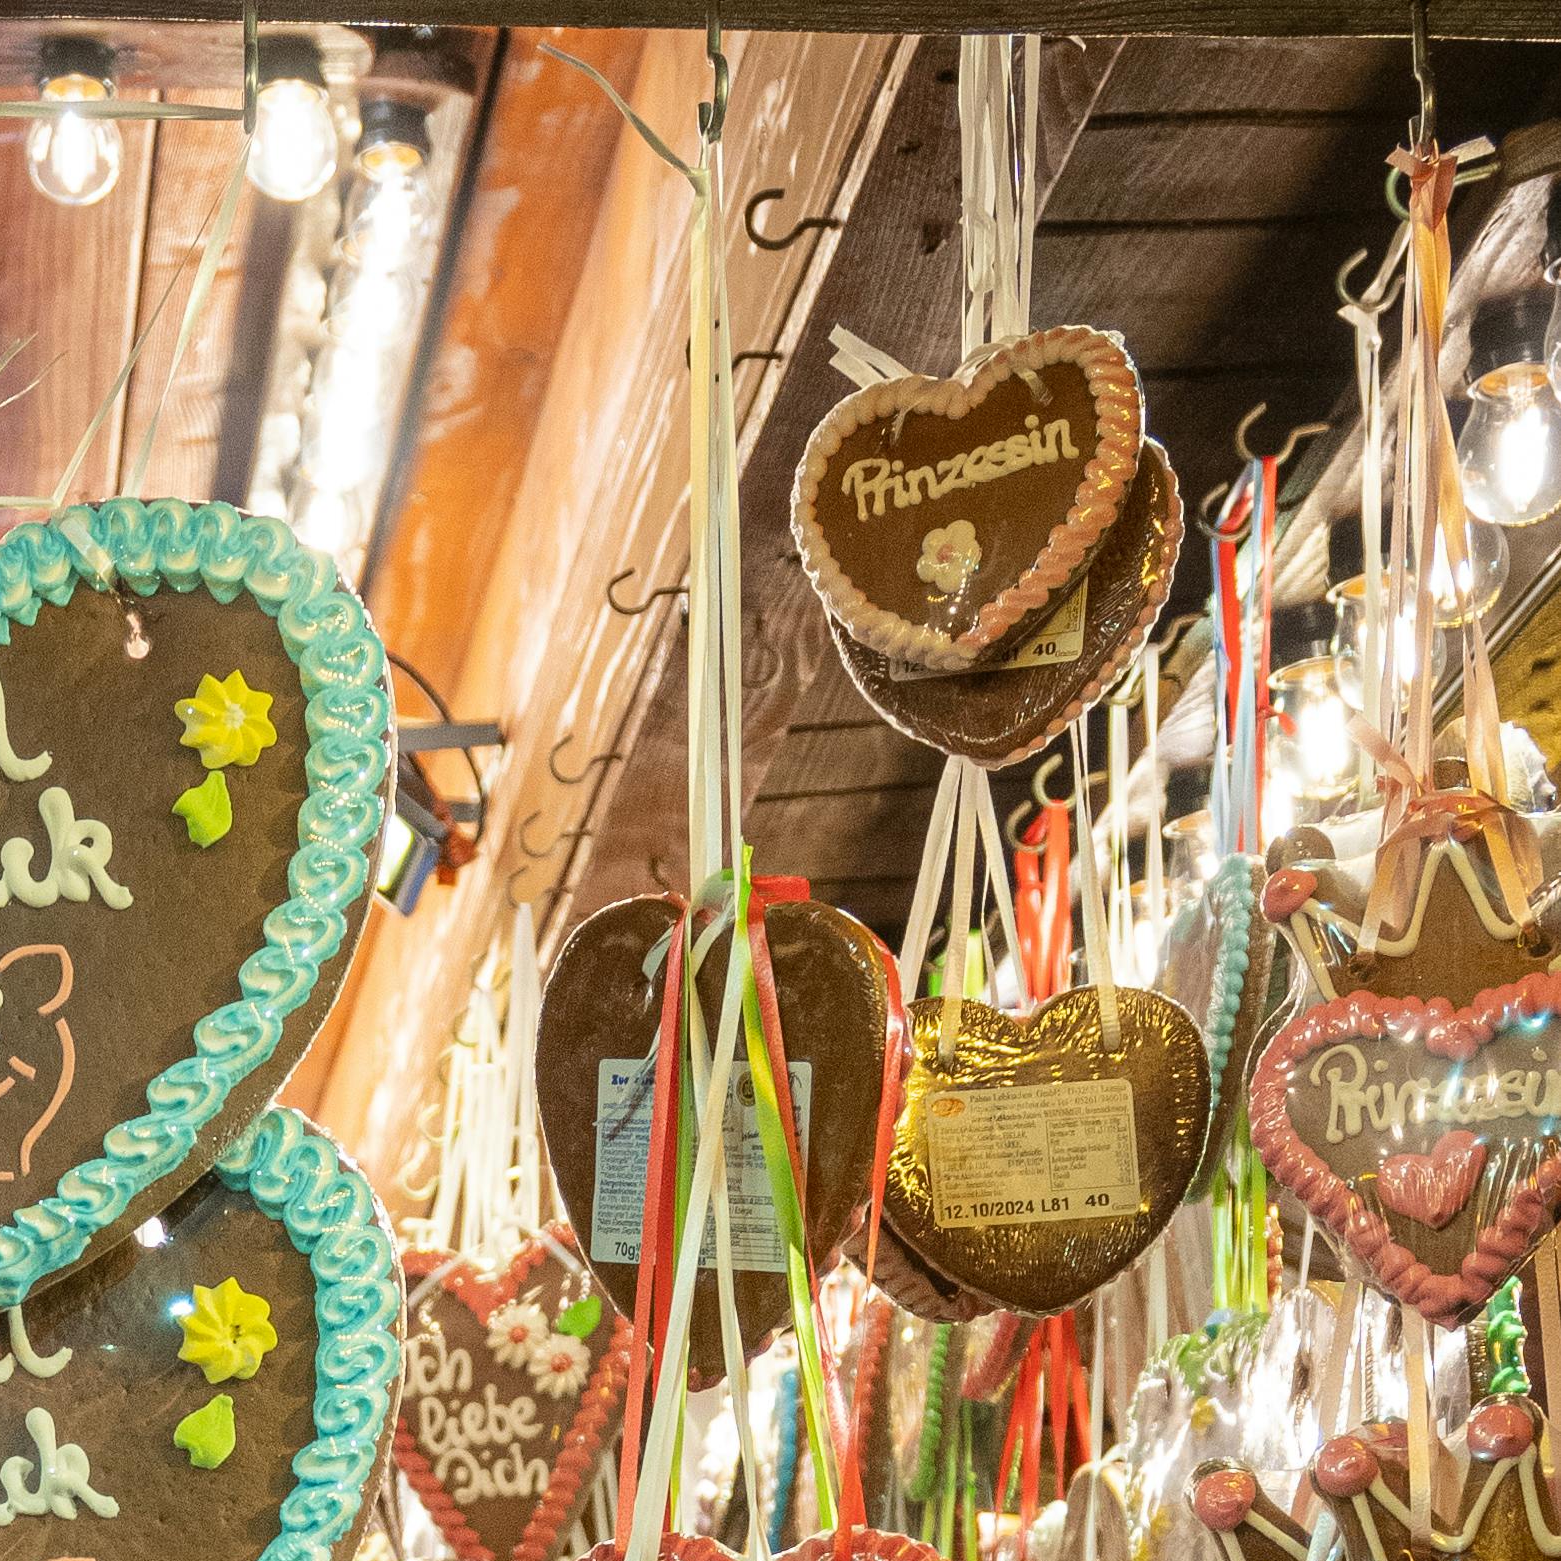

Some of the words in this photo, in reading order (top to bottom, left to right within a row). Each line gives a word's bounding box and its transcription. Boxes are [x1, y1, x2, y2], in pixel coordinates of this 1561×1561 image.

[842, 415, 1079, 521] Prinzessin
[944, 1199, 1035, 1220] 12.10/2024
[1041, 1197, 1070, 1213] L81
[1085, 1193, 1110, 1207] 40
[419, 1383, 543, 1456] liebe
[435, 1442, 550, 1504] Dich
